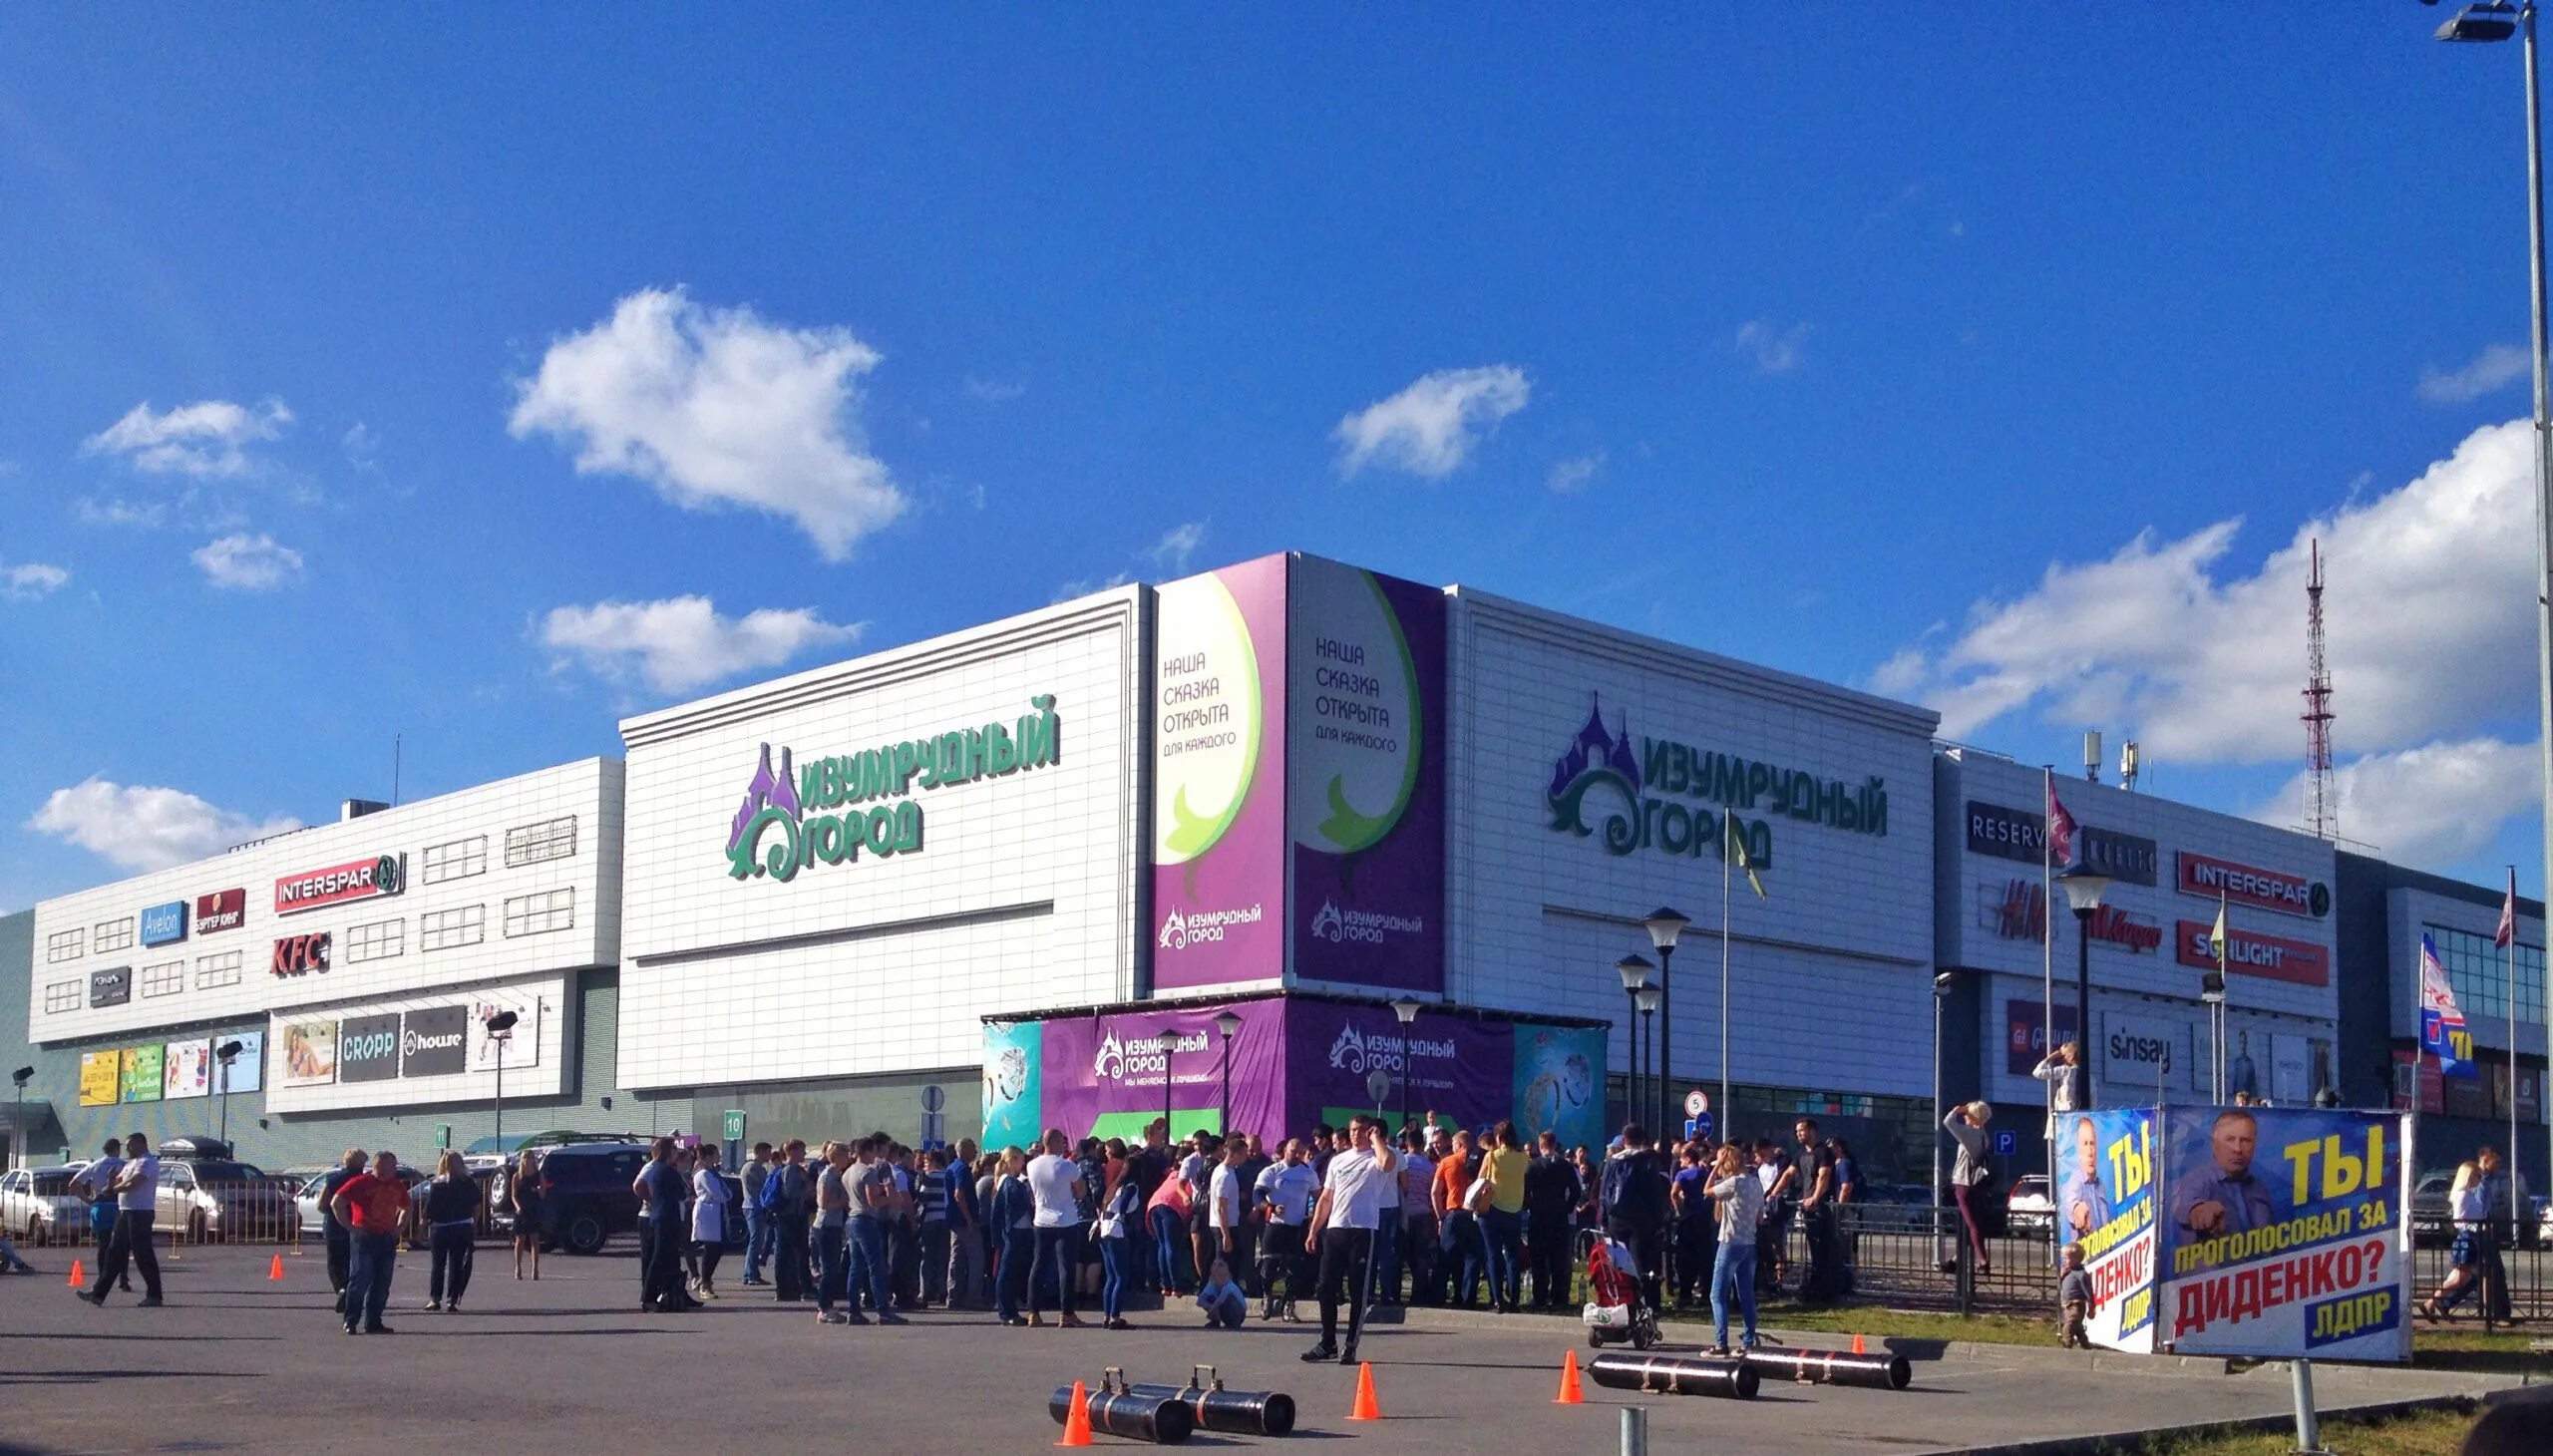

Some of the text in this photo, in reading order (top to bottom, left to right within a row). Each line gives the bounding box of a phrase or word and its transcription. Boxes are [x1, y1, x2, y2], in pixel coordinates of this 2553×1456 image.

[1164, 652, 1206, 678] НАША
[1316, 637, 1364, 666] НАША
[1163, 678, 1220, 706] СКАЗКА
[1316, 667, 1380, 698] СКАЗКА
[1163, 703, 1229, 733] ОТКРЫТА
[1316, 696, 1389, 728] ОТКРЫТА
[801, 693, 1061, 812] ИЗУМРУДНЫЙ
[1164, 732, 1237, 757] ДЛЯ КАЖДОГО
[1316, 725, 1397, 753] ДЛЯ КАЖДОГО
[1645, 735, 1888, 838] ИЗУМРУДНЫЙ
[800, 800, 923, 870] ГОРОД
[279, 866, 372, 904] INTERSPAR
[2195, 863, 2310, 905] INTERSPAR
[145, 909, 178, 936] Avelon
[220, 911, 238, 926] КИНГ
[1188, 903, 1262, 927] ИЗУМРУДНЫЙ
[1344, 910, 1423, 933] ИЗУМРУДНЫЙ
[1188, 926, 1225, 943] ГОРОД
[1344, 925, 1383, 943] ГОРОД
[269, 932, 325, 974] KFC
[344, 1032, 395, 1061] CROPP
[417, 1033, 462, 1050] house
[2110, 1026, 2171, 1074] sinsay
[1125, 1055, 1166, 1074] ГОРОД
[1693, 1099, 1699, 1110] 5
[727, 1118, 740, 1133] 10
[2001, 1134, 2011, 1151] P
[2108, 1120, 2151, 1204] ТЫ
[2284, 1124, 2383, 1207] ТЫ
[2139, 1196, 2152, 1224] ЗА
[2174, 1200, 2387, 1274] ПРОГОЛОСОВАЛ ЗА
[2174, 1240, 2386, 1339] ДИДЕНКО?
[2122, 1286, 2152, 1332] ЛДПР
[2312, 1293, 2391, 1339] ЛДПР
